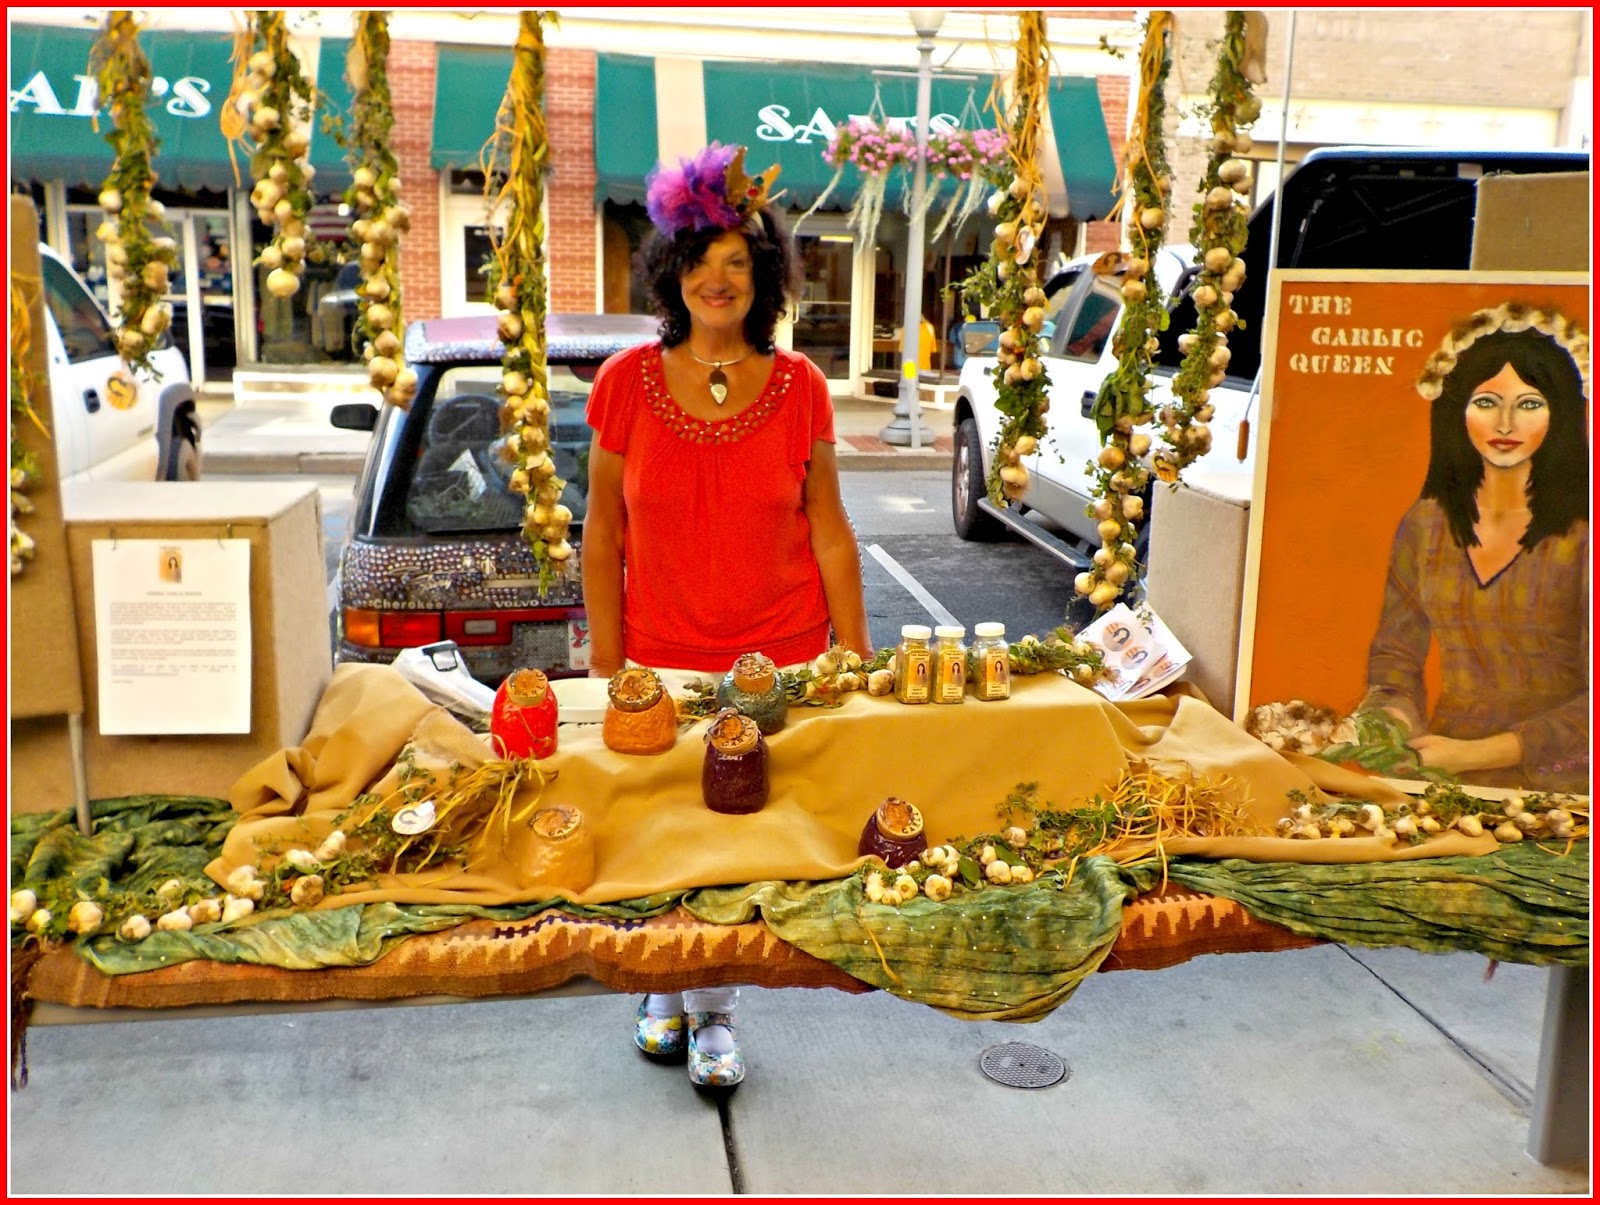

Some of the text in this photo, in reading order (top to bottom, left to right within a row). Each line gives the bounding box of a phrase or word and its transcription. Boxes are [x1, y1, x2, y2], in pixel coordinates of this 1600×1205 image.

[11, 70, 211, 118] A'S
[1288, 294, 1352, 315] THE
[1311, 326, 1424, 347] GARLIC
[1289, 353, 1394, 375] QUEEN
[373, 598, 444, 610] Cherokee
[495, 599, 540, 609] VOLVO
